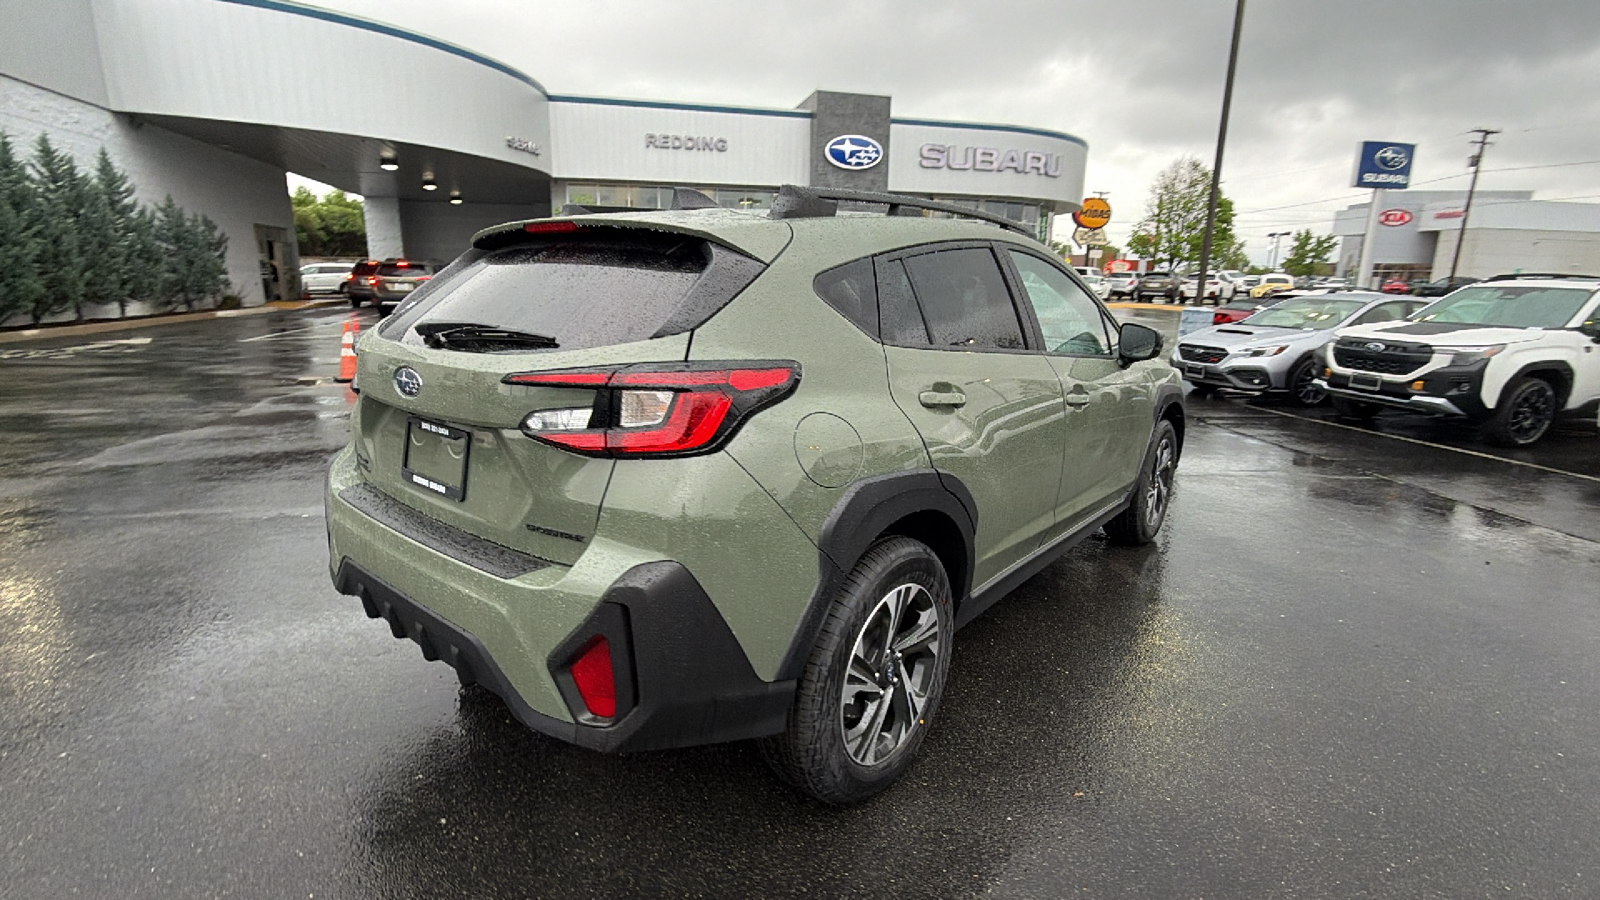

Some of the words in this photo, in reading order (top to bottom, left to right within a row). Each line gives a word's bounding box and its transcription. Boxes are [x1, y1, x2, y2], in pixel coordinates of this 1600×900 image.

[645, 133, 728, 153] REDDING
[919, 143, 1064, 178] SUBARU
[1362, 172, 1409, 184] SUBARU
[1080, 209, 1111, 219] MIDAS
